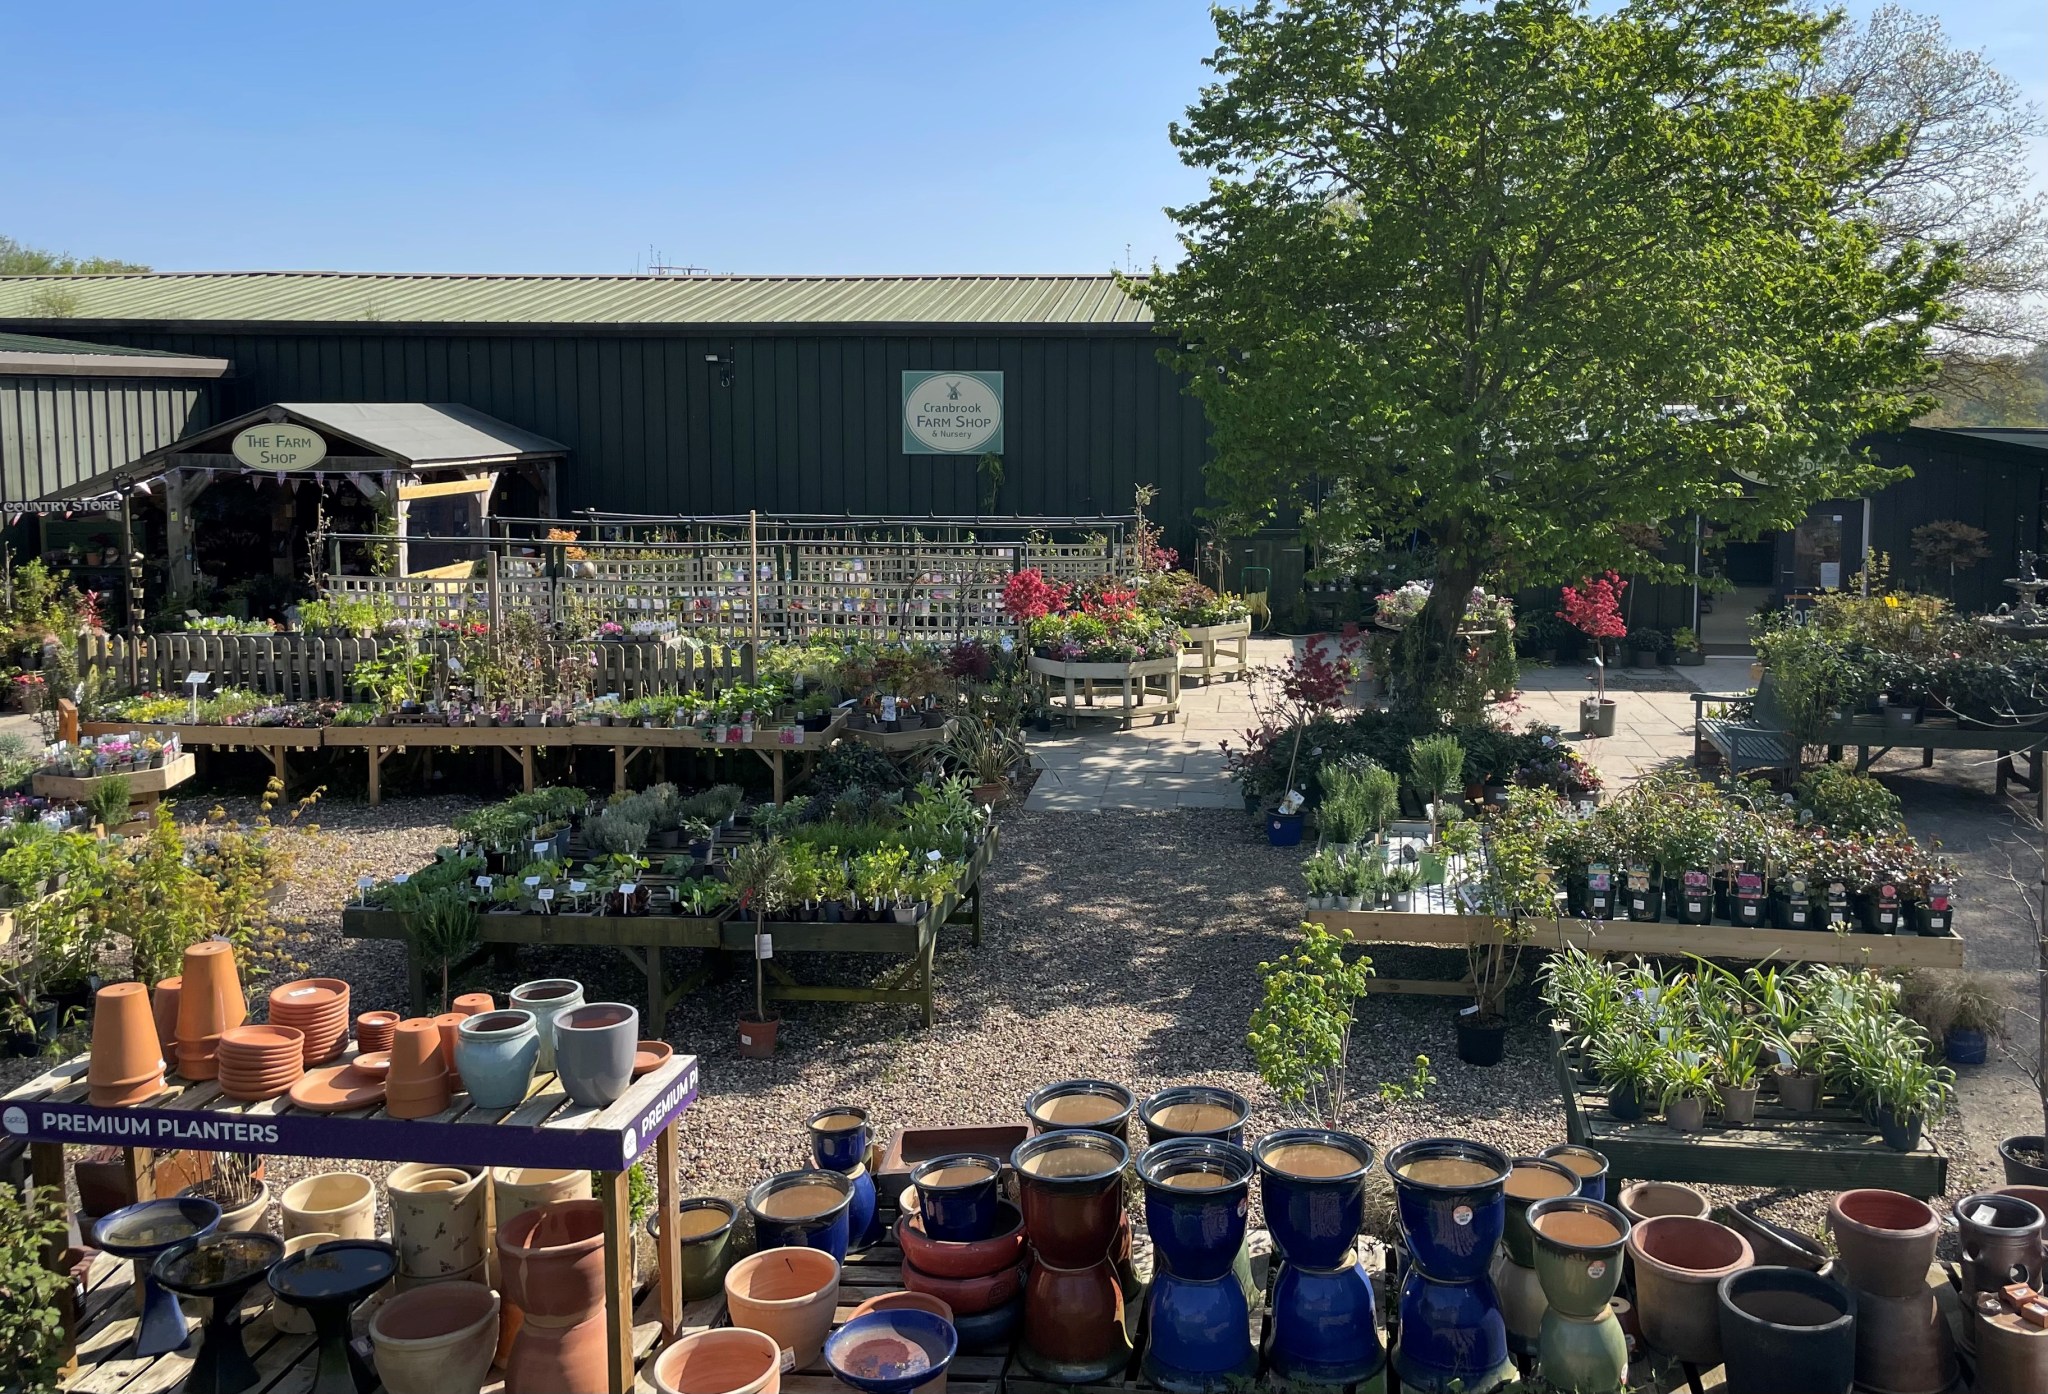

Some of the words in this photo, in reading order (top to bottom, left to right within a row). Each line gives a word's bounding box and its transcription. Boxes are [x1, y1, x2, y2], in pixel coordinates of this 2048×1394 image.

[923, 402, 982, 413] Cranbrook
[916, 415, 951, 428] FARM
[955, 415, 992, 428] SHOP
[244, 434, 270, 448] THE
[276, 435, 312, 448] FARM
[931, 430, 938, 438] &
[940, 430, 972, 439] Nursery
[260, 450, 297, 464] SHOP
[3, 501, 70, 512] COUNTRY
[72, 500, 121, 511] STORE
[641, 1076, 689, 1138] PREMIUM
[42, 1112, 151, 1136] PREMIUM
[157, 1118, 280, 1143] PLANTERS
